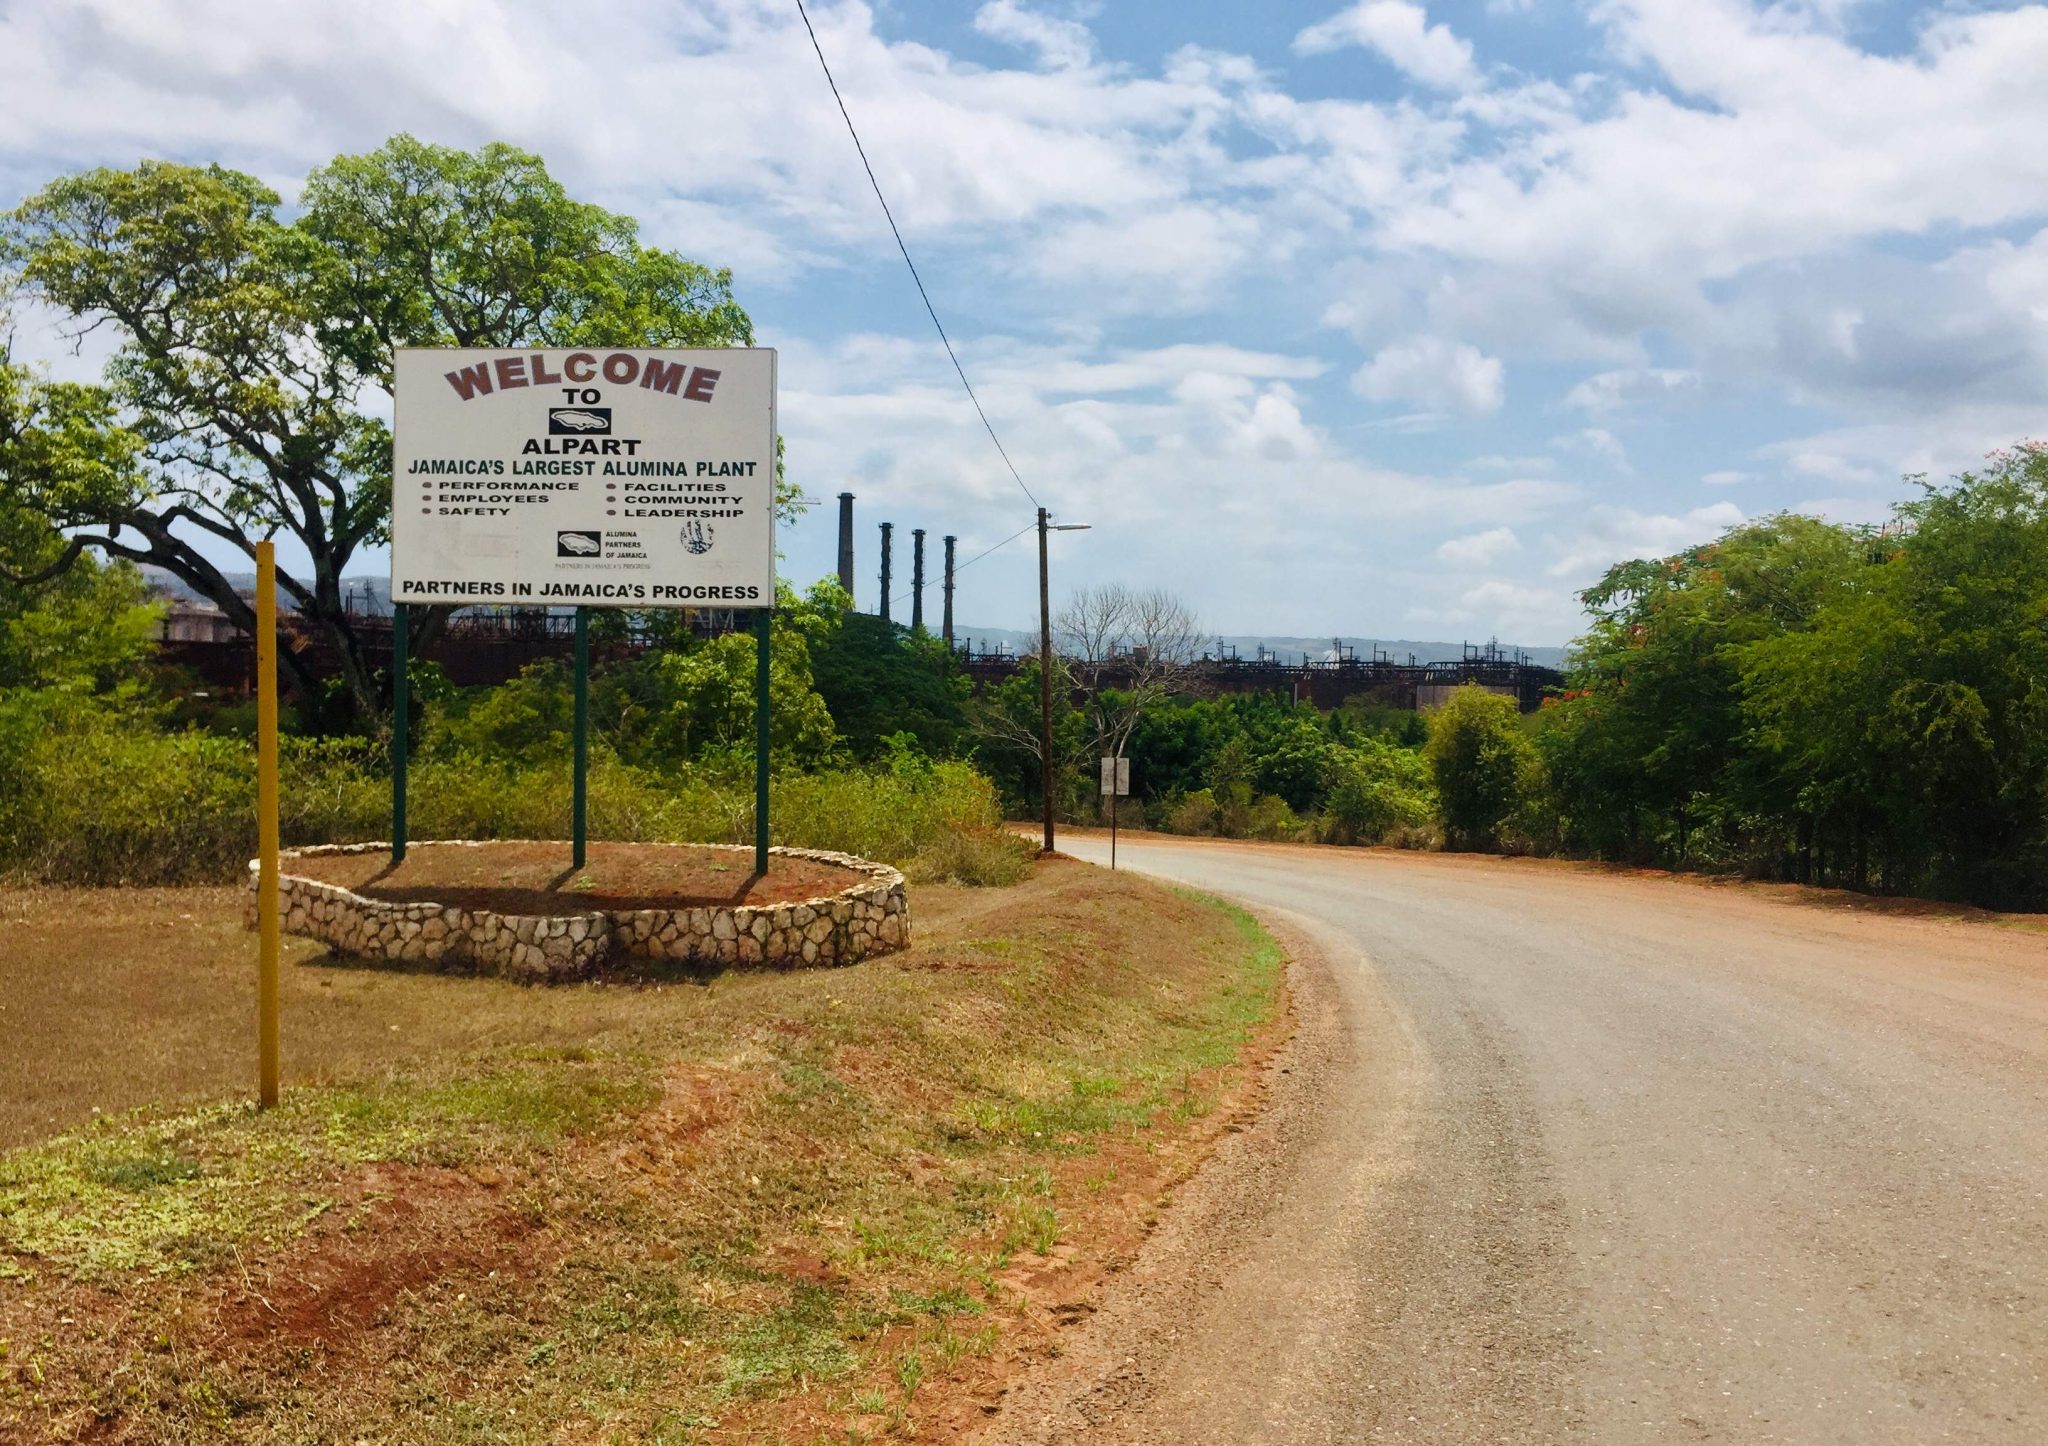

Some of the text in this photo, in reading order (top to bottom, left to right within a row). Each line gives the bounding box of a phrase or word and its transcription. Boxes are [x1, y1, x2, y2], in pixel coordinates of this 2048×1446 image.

[444, 353, 721, 402] WELCOME
[562, 389, 601, 404] TO
[522, 439, 641, 455] ALPART
[513, 460, 595, 475] LARGEST
[603, 461, 687, 476] ALUMINA
[696, 462, 756, 477] PLANT
[439, 482, 579, 491] PERFORMANCE
[624, 483, 726, 492] FACILITIES
[439, 494, 549, 503] EMPLOYEES
[624, 496, 744, 504] COMMUNITY
[439, 507, 510, 516] SAFETY
[624, 509, 744, 518] LEADERSHIP
[403, 581, 504, 596] PARTNERS
[512, 582, 532, 595] IN
[653, 585, 759, 599] PROGRESS
